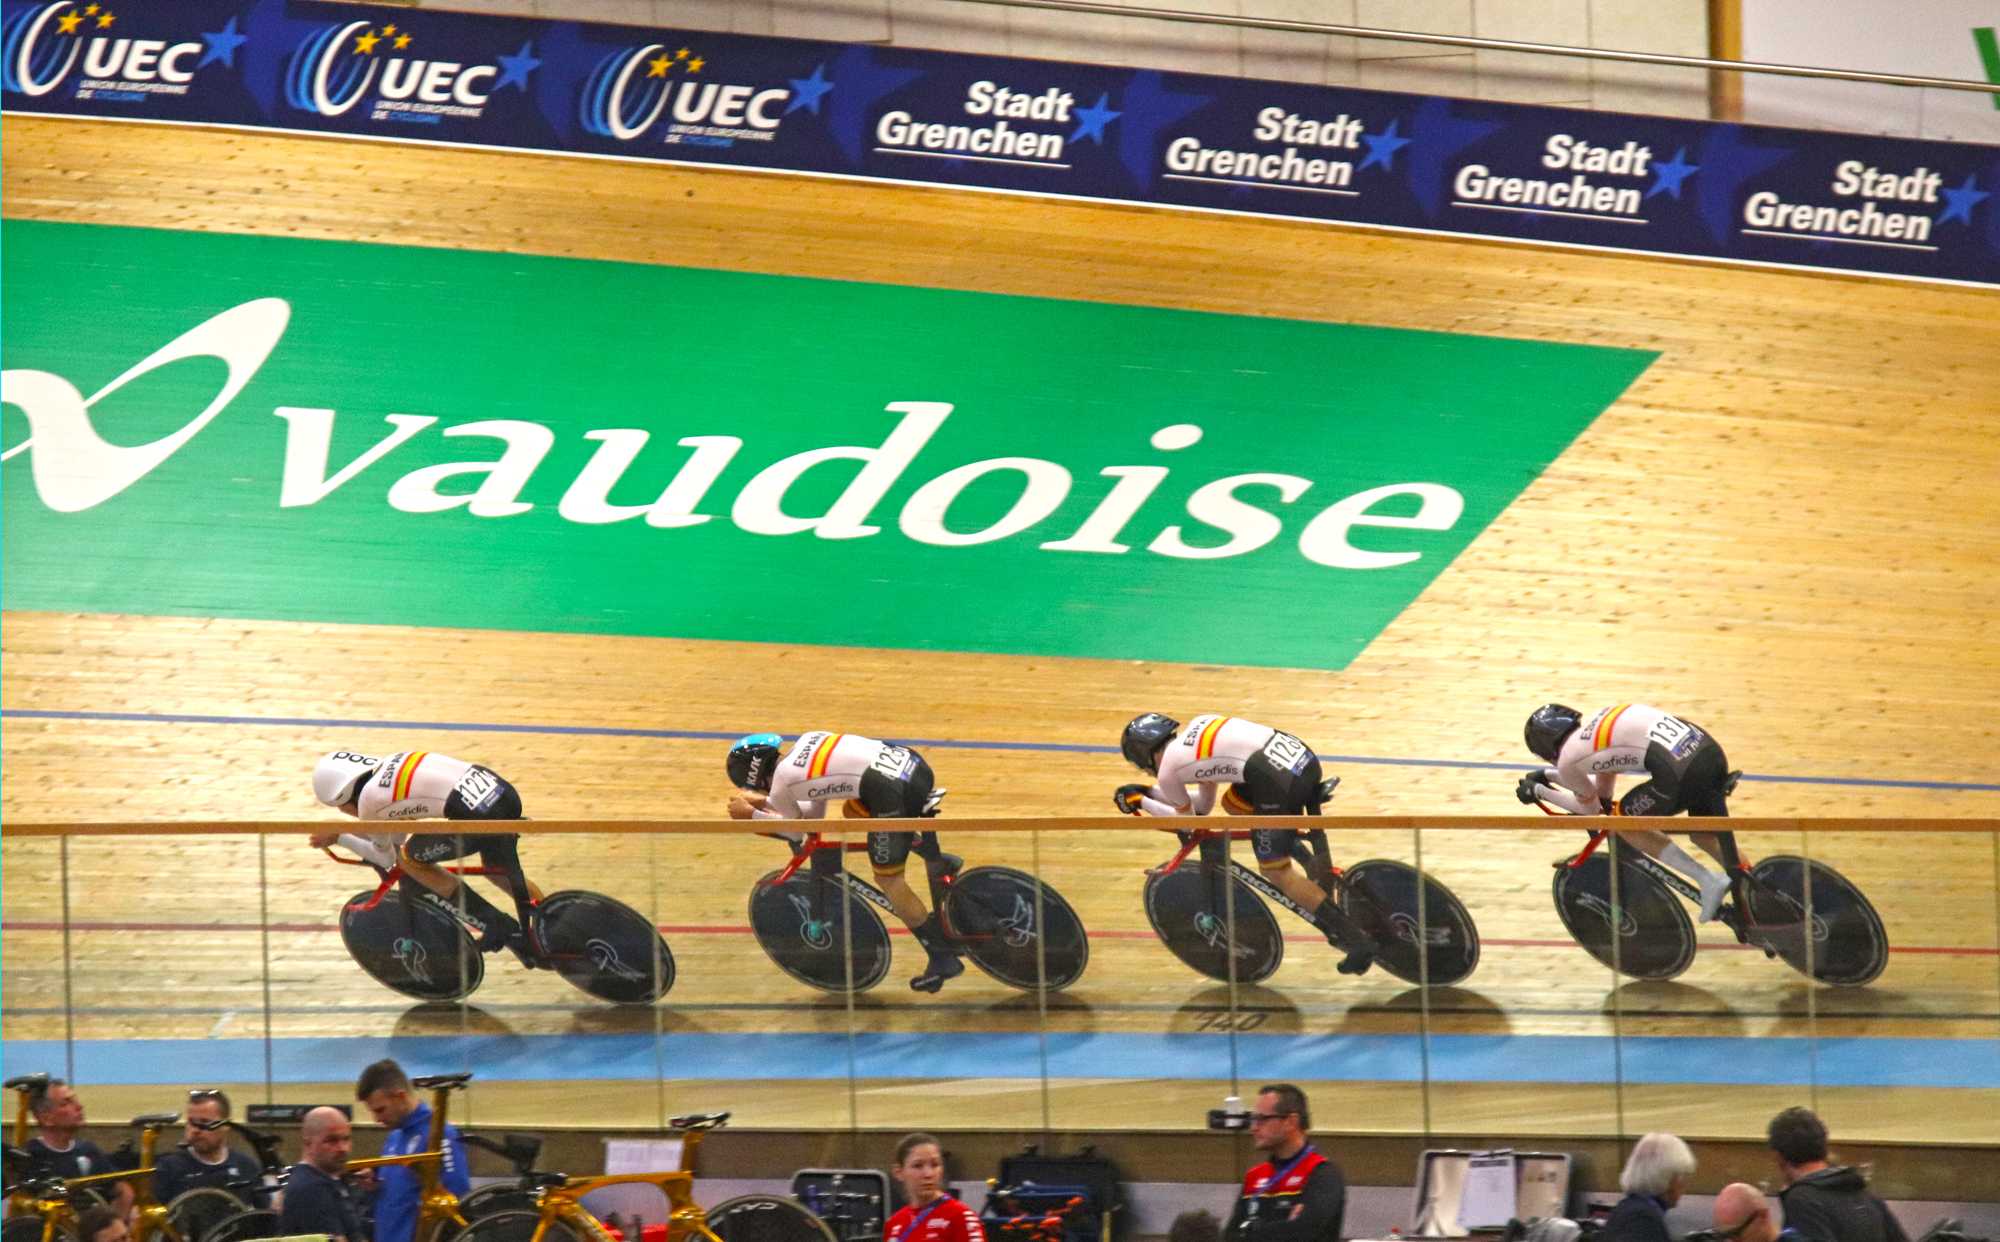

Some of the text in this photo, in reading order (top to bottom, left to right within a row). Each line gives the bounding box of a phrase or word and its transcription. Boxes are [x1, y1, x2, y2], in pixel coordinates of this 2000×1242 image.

[84, 38, 203, 82] UEC
[378, 58, 498, 104] UEC
[672, 82, 790, 128] UEC
[964, 80, 1074, 122] Stadt
[876, 110, 1064, 158] Grenchen
[1253, 106, 1364, 149] Stadt
[1165, 136, 1354, 186] Grenchen
[1542, 134, 1653, 176] Stadt
[1454, 164, 1642, 214] Grenchen
[1831, 160, 1943, 203] Stadt
[1744, 191, 1932, 241] Grenchen
[273, 401, 1465, 570] vaudoise
[1650, 715, 1685, 744] 131
[1194, 763, 1240, 779] Cofidis
[1592, 753, 1640, 772] Cofidis
[458, 771, 491, 801] 127
[808, 783, 854, 799] Cofidis
[388, 804, 430, 819] Cofidis
